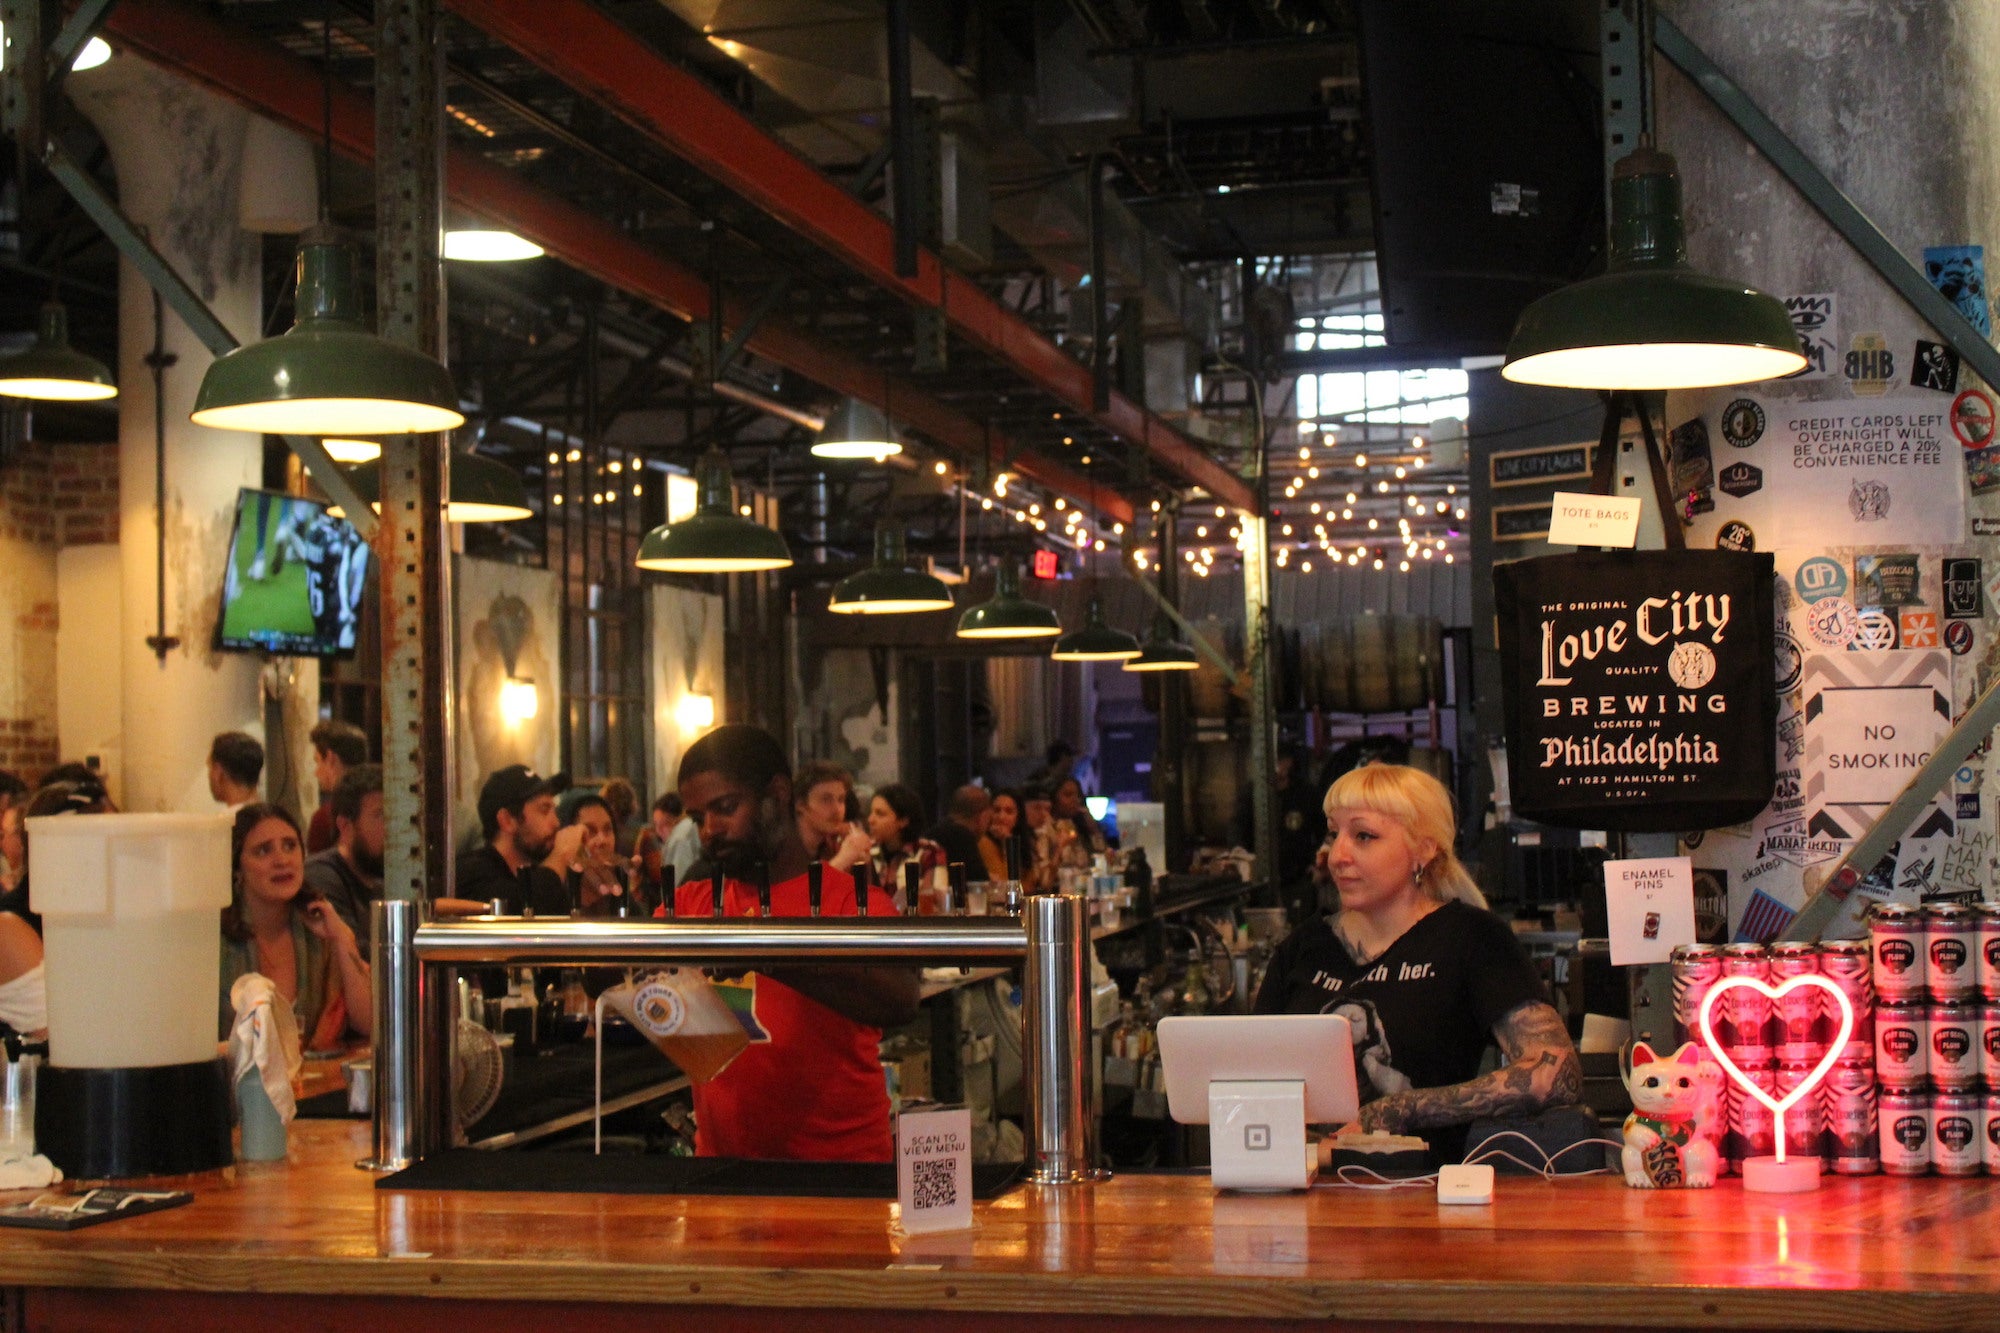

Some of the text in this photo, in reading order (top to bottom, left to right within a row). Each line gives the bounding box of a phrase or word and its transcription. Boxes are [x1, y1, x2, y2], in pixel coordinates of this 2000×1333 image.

[1789, 417, 1844, 431] CREDIT
[1851, 415, 1903, 428] CARDS
[1909, 415, 1943, 427] LEFT
[1799, 428, 1935, 443] OVERNIGHT WILL
[1794, 440, 1942, 456] BE CHARGED A 20%
[1793, 453, 1941, 468] CONVENIENCE FEE
[1562, 507, 1630, 521] TOTE BAGS
[1541, 600, 1628, 613] THE ORIGINAL
[1536, 590, 1731, 687] Love City
[1605, 665, 1661, 676] QUALITY
[1543, 694, 1726, 717] BREWING
[1593, 719, 1661, 729] LOCATED IN
[1864, 725, 1896, 740] NO
[1539, 732, 1720, 771] Philadelphia
[1557, 776, 1572, 786] AT
[1579, 775, 1607, 785] 1023
[1614, 774, 1676, 784] HAMILTON
[1623, 869, 1674, 880] ENAMEL
[1634, 880, 1664, 890] PINS
[1312, 970, 1343, 991] I'm
[1398, 961, 1435, 982] her.
[912, 1133, 957, 1145] SCAN TO
[904, 1143, 965, 1155] VIEW MENU
